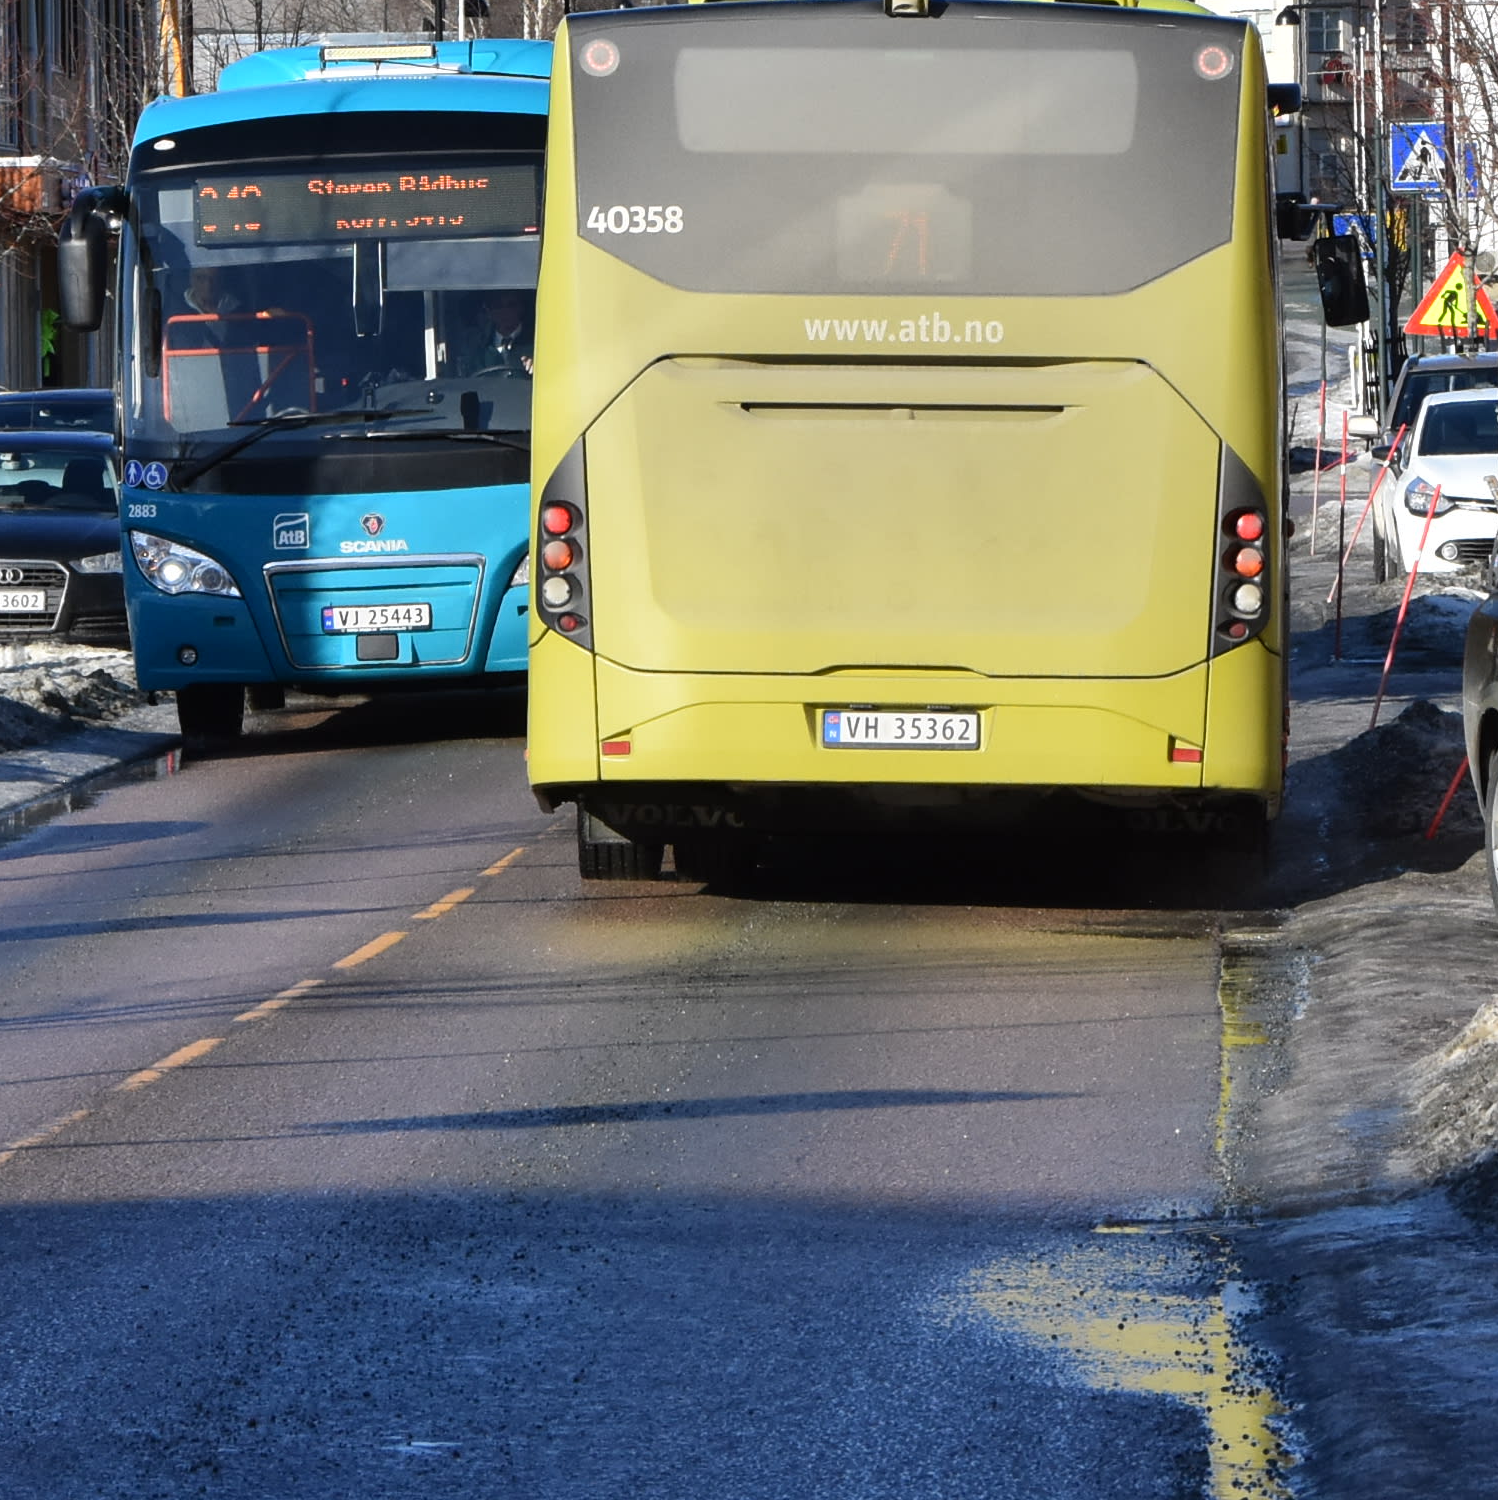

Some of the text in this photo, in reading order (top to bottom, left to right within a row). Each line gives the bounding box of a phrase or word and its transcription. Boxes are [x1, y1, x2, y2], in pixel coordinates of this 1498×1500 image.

[587, 206, 684, 234] 40358
[804, 312, 1005, 344] www.atb.no
[128, 504, 157, 518] 2883
[278, 531, 305, 545] AtB
[339, 540, 409, 553] SCANIA
[339, 608, 423, 626] VJ 25443
[846, 716, 971, 741] VH 35362
